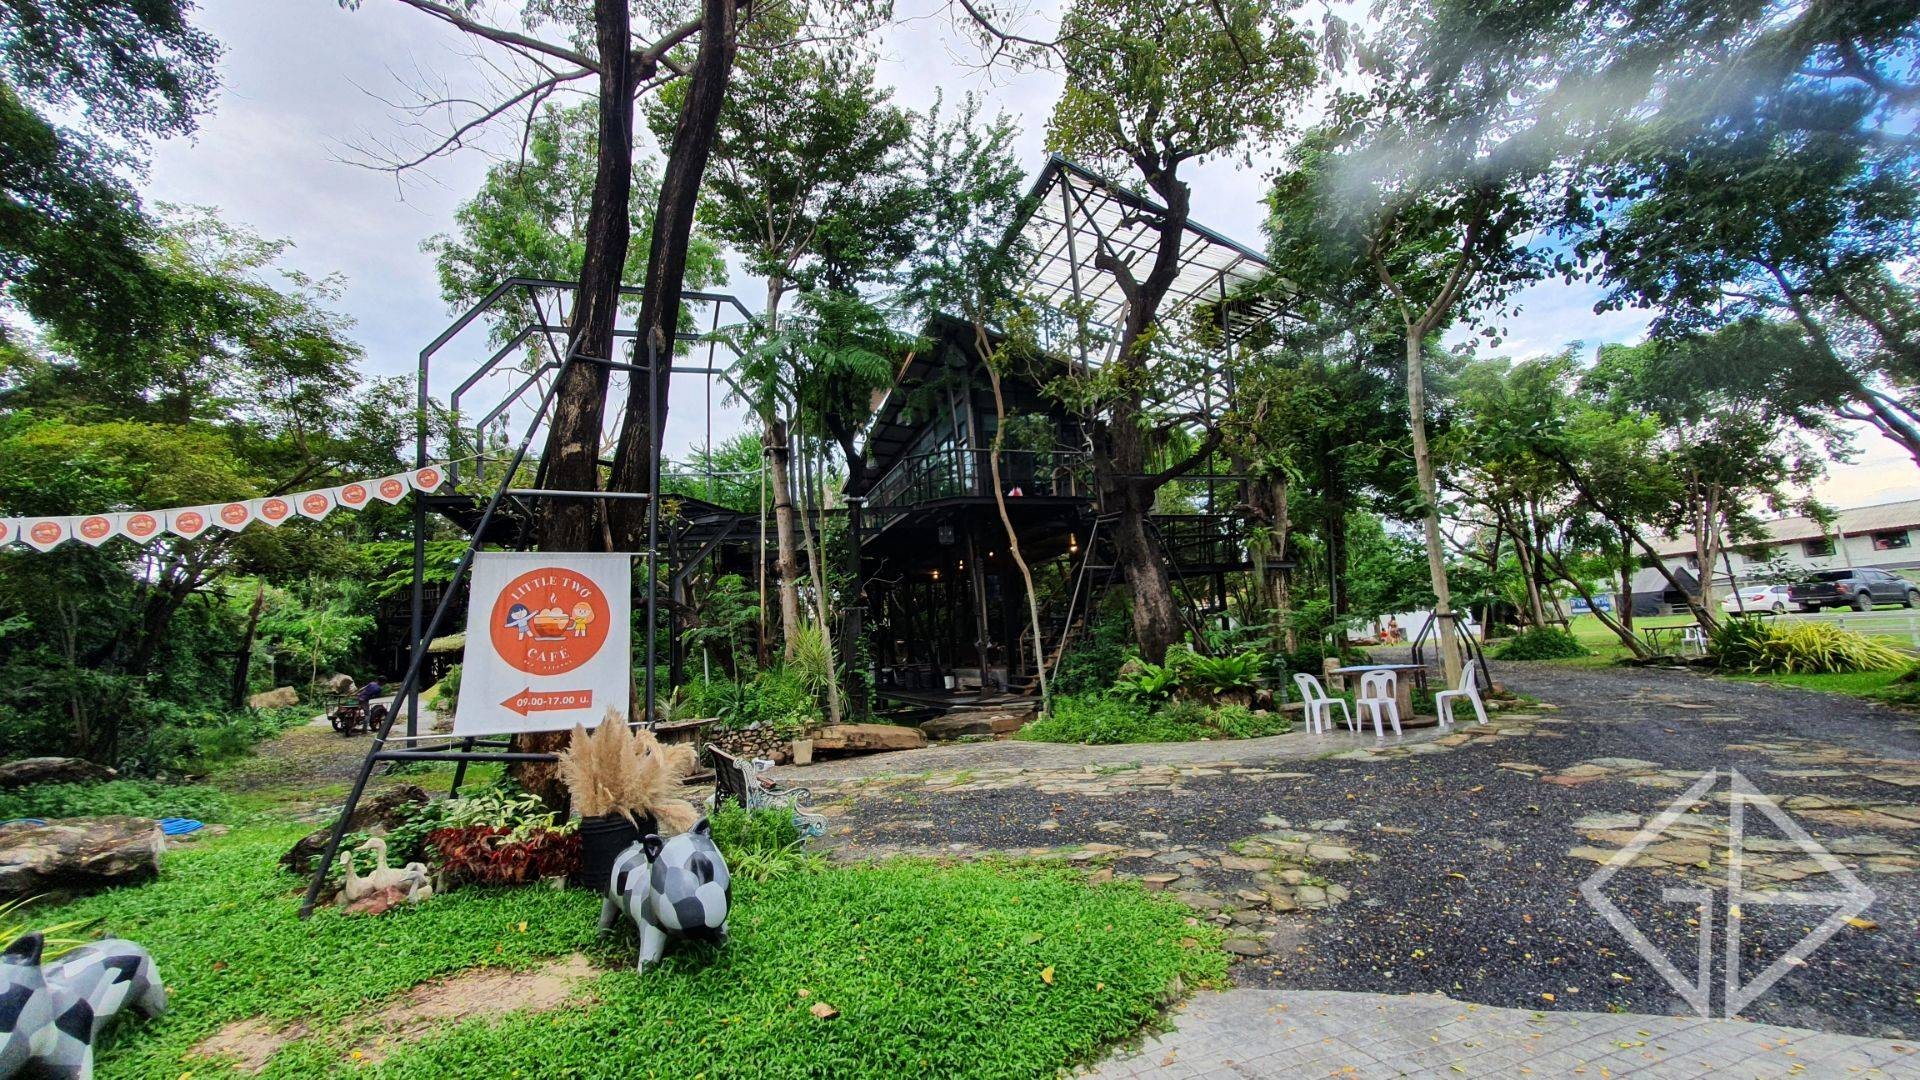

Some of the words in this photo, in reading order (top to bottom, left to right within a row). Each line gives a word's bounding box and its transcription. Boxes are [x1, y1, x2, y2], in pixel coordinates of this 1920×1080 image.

[511, 576, 557, 600] LITTLE
[562, 577, 592, 598] TWO
[516, 696, 575, 707] 09.00-17.00
